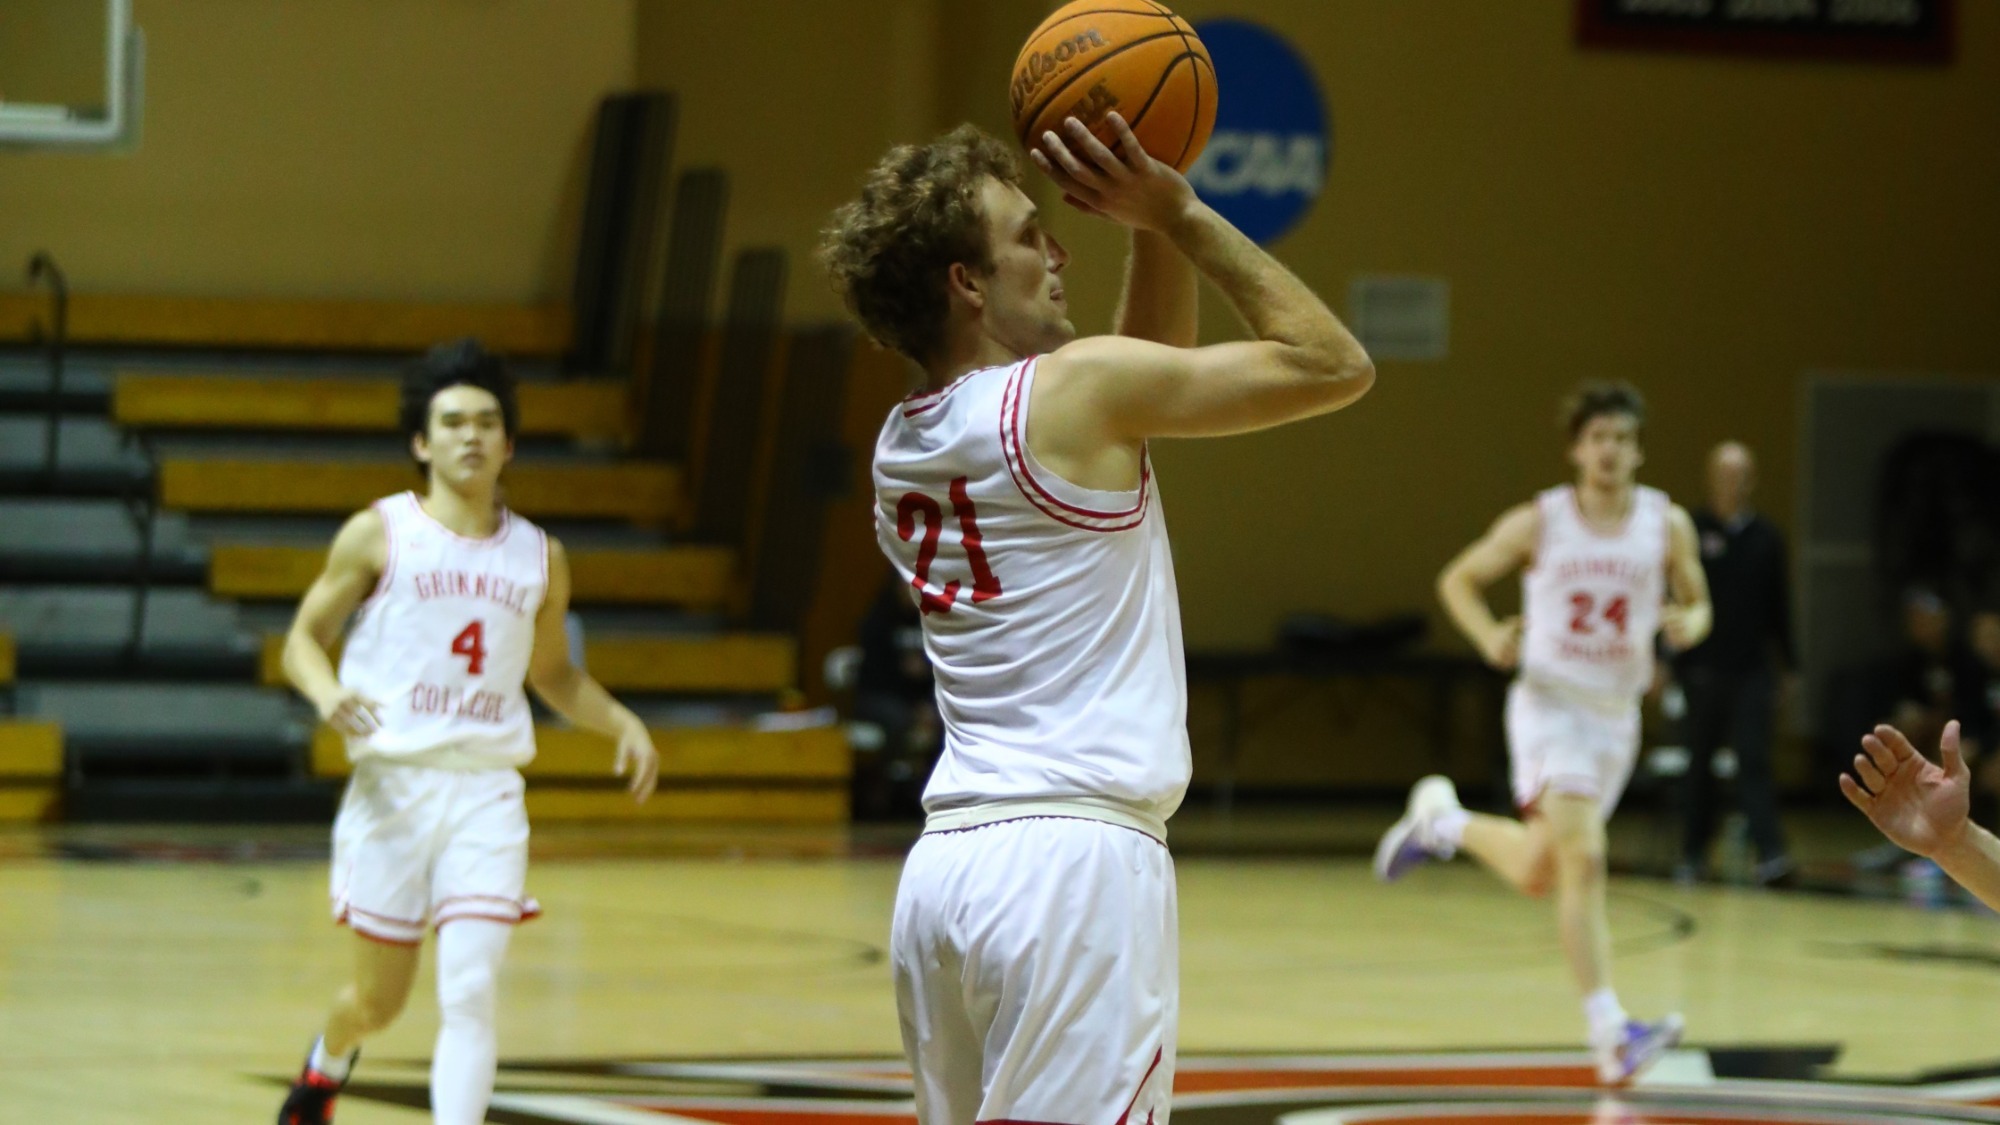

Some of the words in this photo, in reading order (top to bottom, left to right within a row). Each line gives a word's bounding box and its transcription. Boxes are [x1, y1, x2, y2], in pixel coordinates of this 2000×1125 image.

[1184, 134, 1323, 196] CAA
[897, 475, 1003, 616] 21
[1568, 590, 1630, 635] 24
[451, 619, 487, 675] 4
